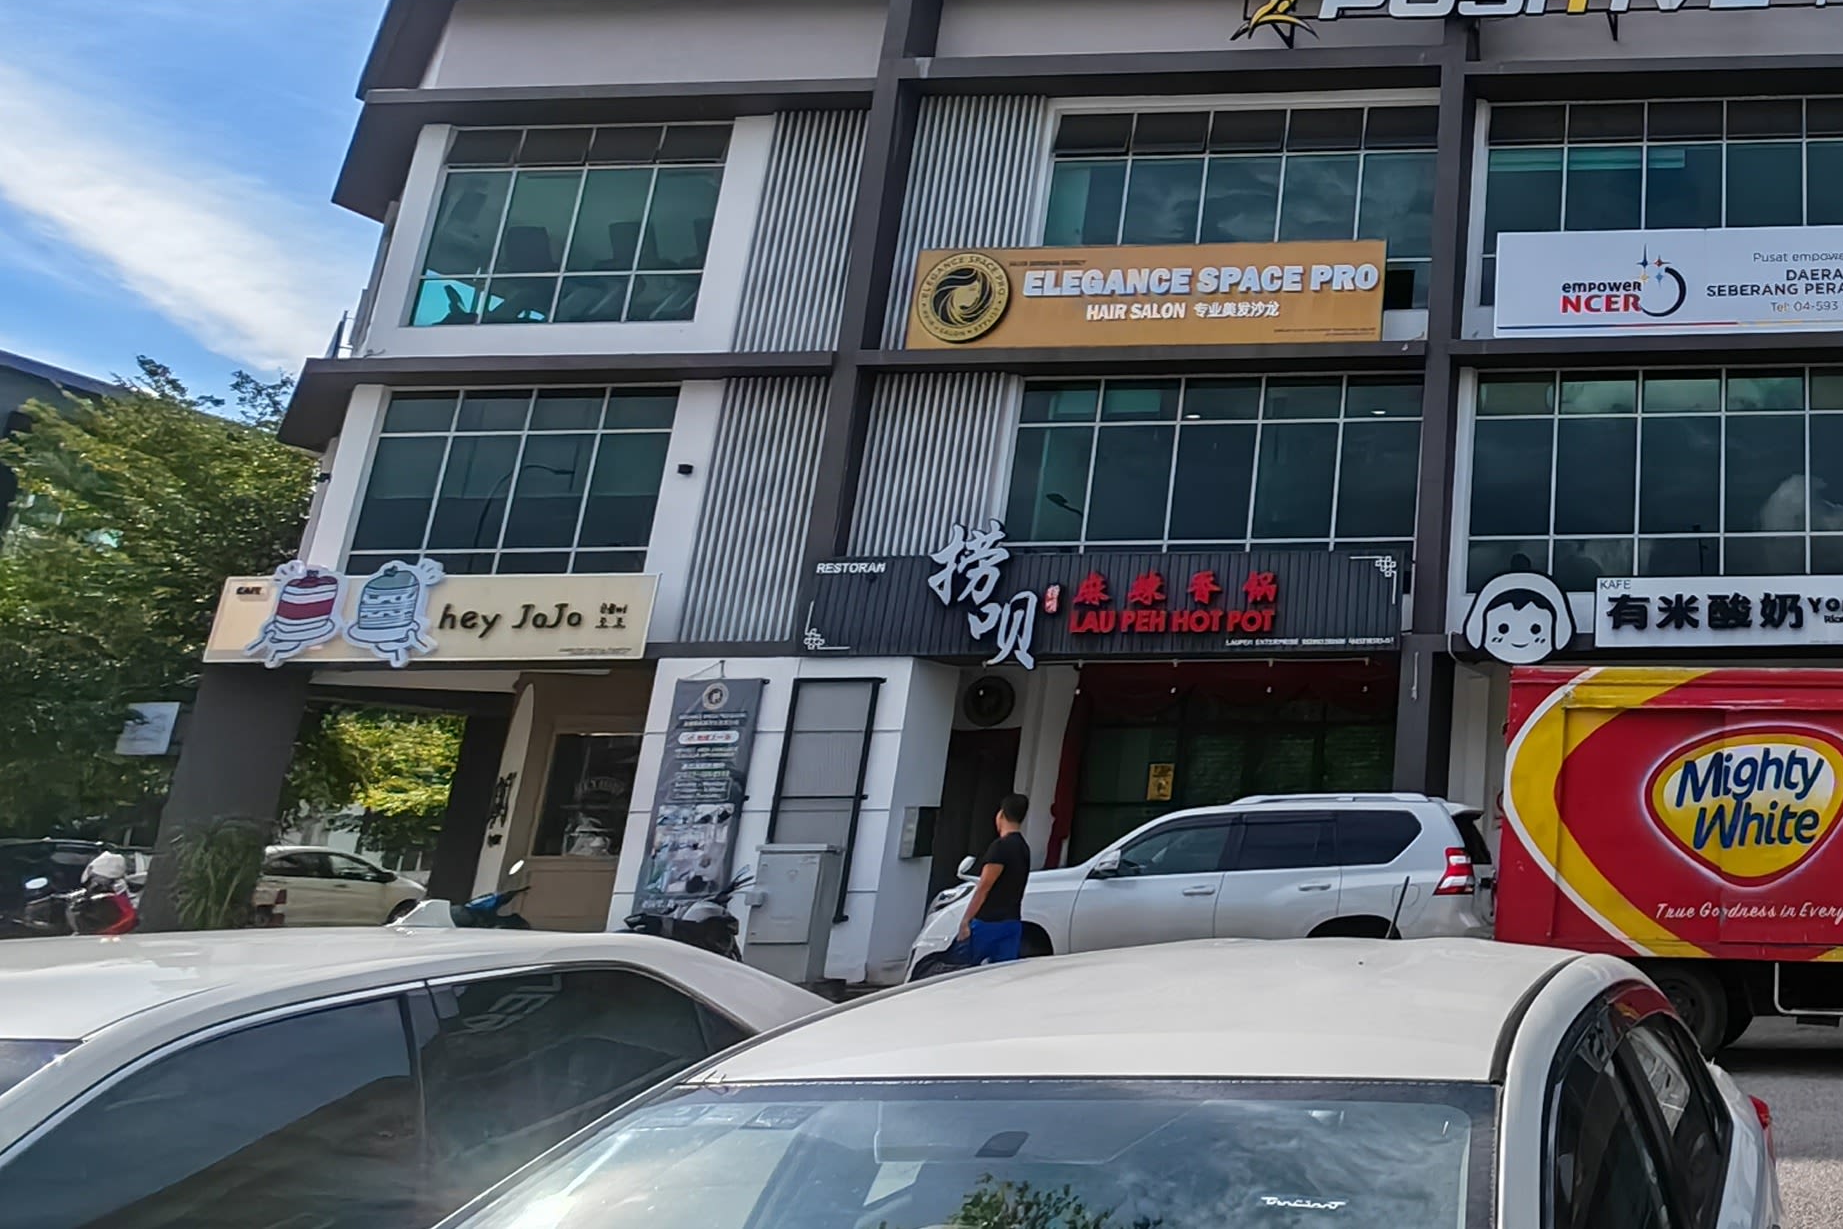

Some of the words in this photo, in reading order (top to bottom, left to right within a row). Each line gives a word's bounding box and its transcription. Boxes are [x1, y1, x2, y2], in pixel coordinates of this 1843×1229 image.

[1753, 252, 1788, 262] Pusat
[1022, 268, 1192, 298] ELEGANCE
[1196, 265, 1304, 294] SPACE
[1309, 263, 1380, 292] PRO
[1561, 280, 1642, 293] empower
[1706, 282, 1799, 297] SEBERANG
[1086, 303, 1125, 321] HAIR
[1129, 302, 1186, 320] SALON
[1193, 300, 1280, 319] 专业美发沙龙
[1561, 293, 1643, 313] NCER
[1793, 301, 1838, 312] 04-593
[816, 562, 886, 574] RESTORAN
[1073, 570, 1278, 605] 麻辣香锅
[1600, 579, 1631, 590] KAFE
[438, 602, 502, 638] hey
[511, 603, 583, 629] JoJo
[1606, 592, 1804, 630] 有米酸奶
[1069, 610, 1116, 634] LAU
[1119, 610, 1167, 633] PEH
[1170, 610, 1224, 633] HOT
[1226, 609, 1277, 632] POT
[1675, 747, 1825, 808] Mighty
[1693, 795, 1820, 850] White
[1655, 903, 1696, 918] True
[1780, 903, 1797, 918] in
